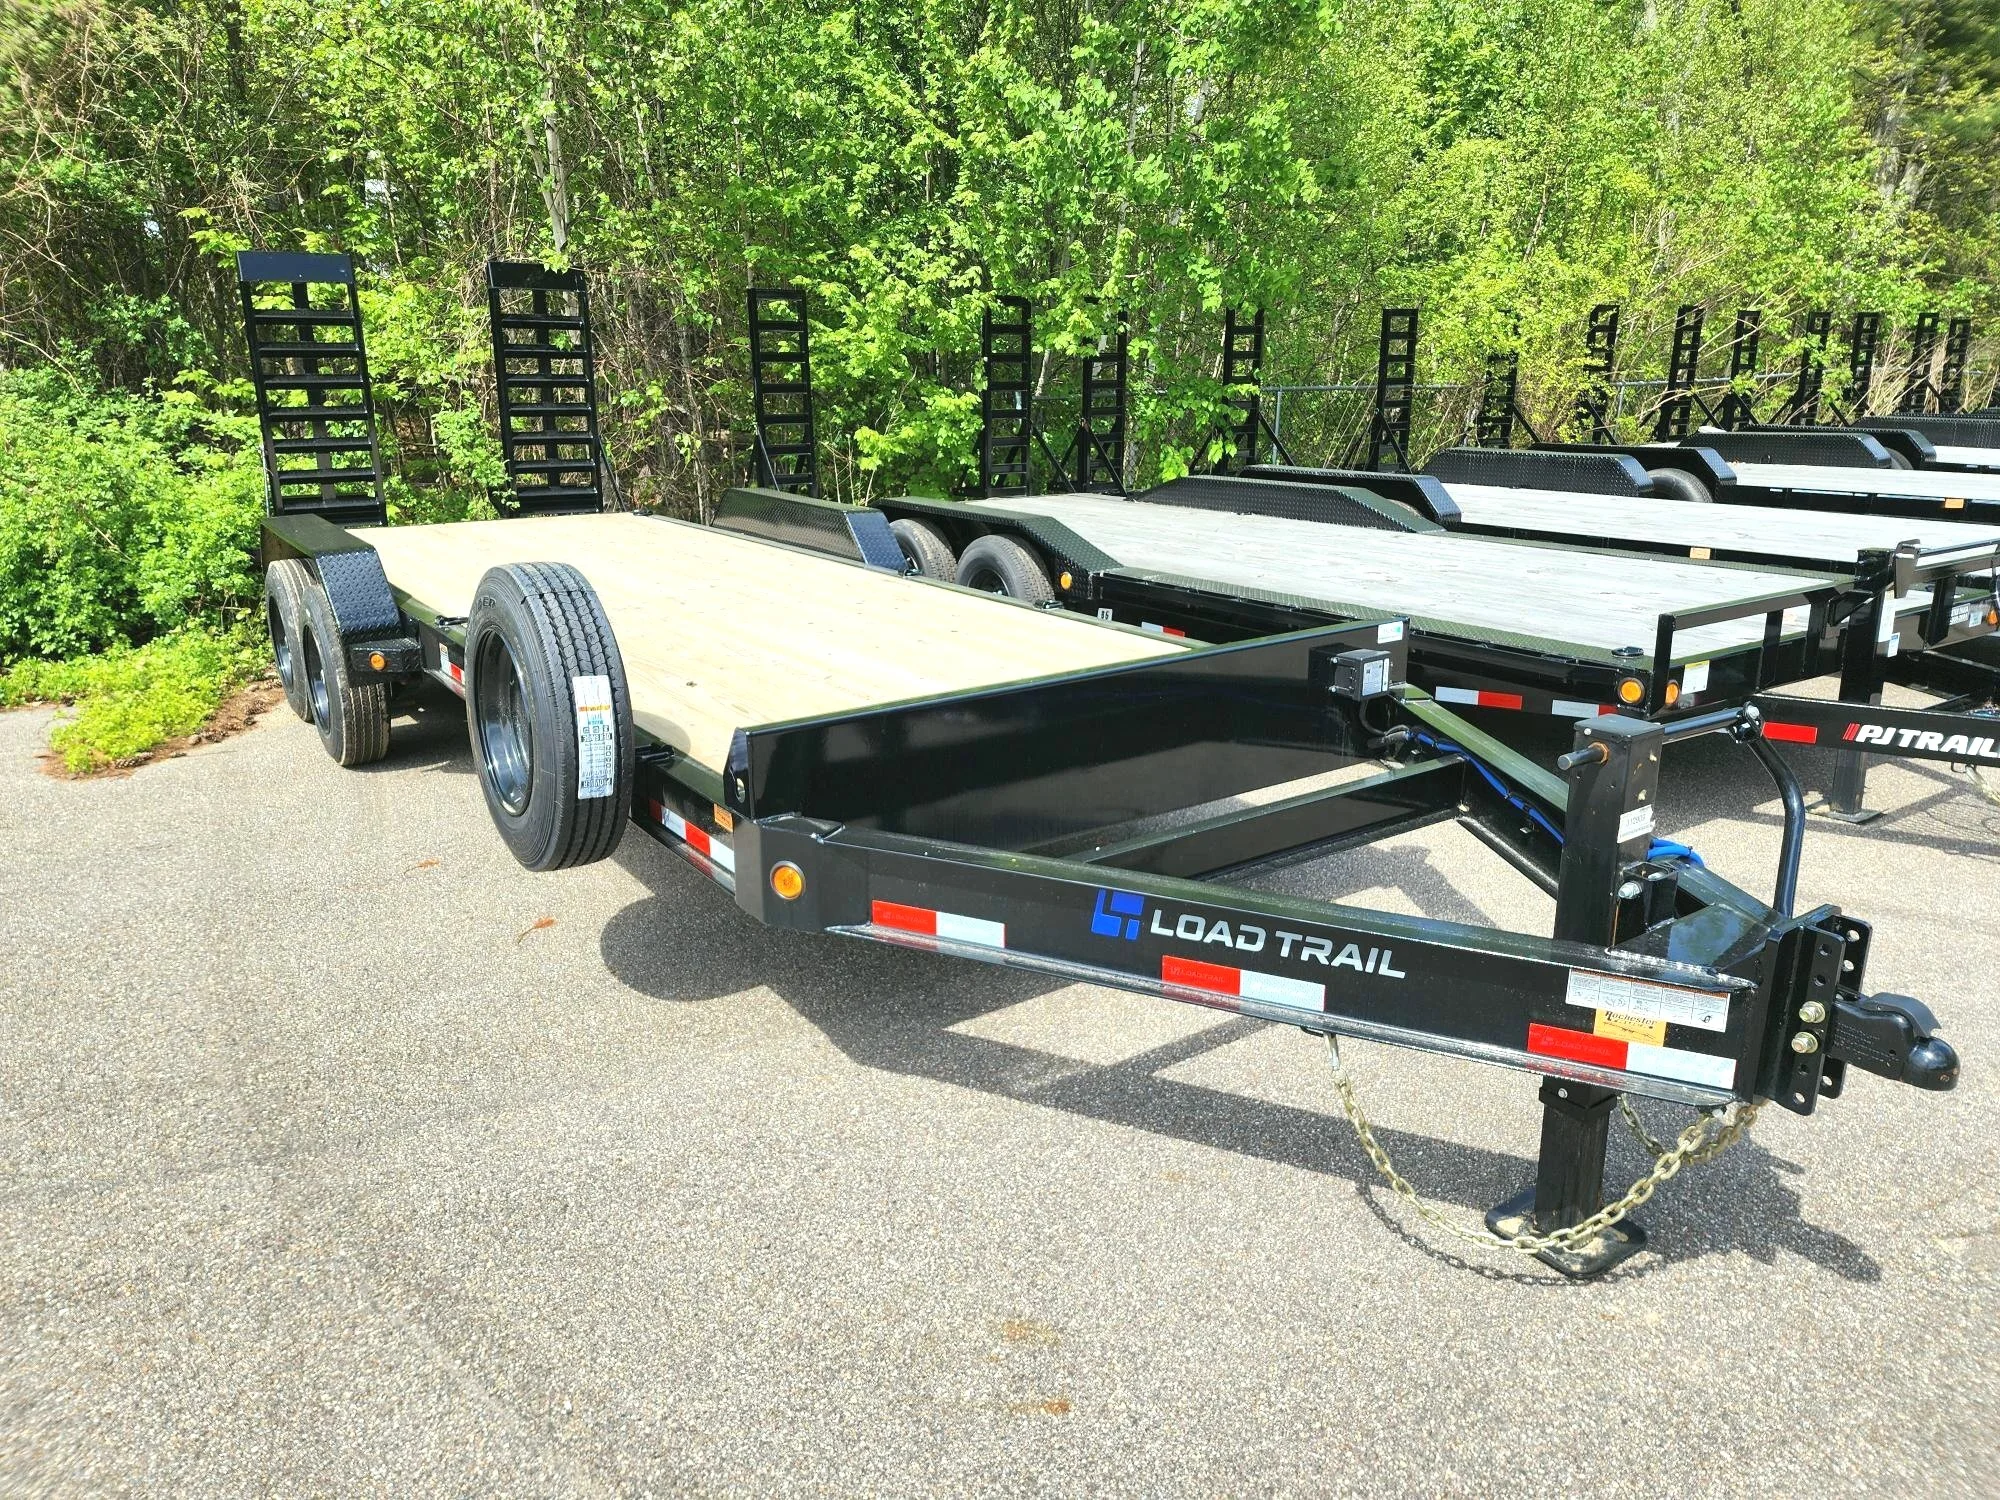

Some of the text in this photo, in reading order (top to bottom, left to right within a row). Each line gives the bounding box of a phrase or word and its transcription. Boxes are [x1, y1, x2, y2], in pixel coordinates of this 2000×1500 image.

[1856, 724, 2000, 759] PJ TRAIL
[1150, 909, 1266, 952] LOAD
[1274, 930, 1406, 980] TRAIL
[1605, 1011, 1658, 1026] Rochester
